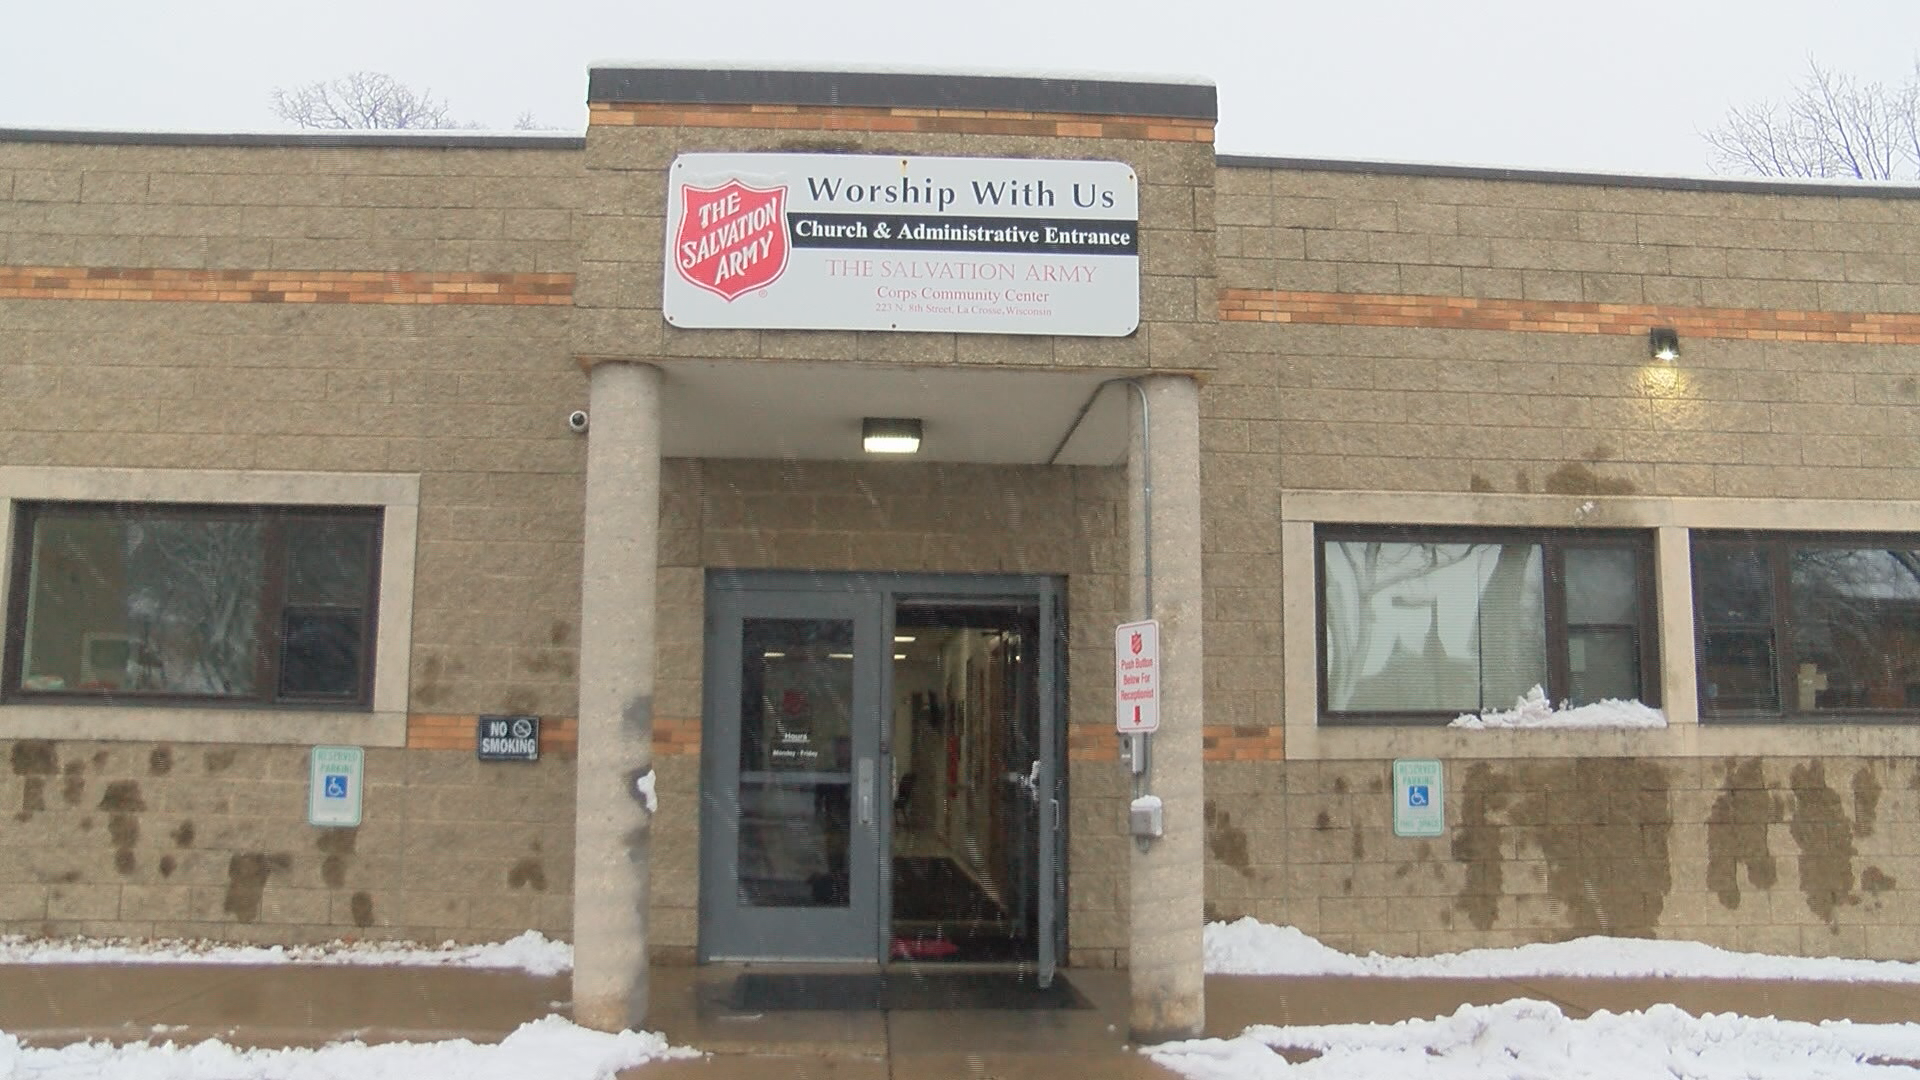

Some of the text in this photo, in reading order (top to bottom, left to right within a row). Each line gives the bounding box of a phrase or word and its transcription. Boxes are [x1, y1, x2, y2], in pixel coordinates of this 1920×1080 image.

[807, 176, 1114, 212] Worship With Us
[698, 191, 742, 229] THE
[682, 196, 777, 269] SALVATION
[795, 219, 1131, 245] Church & Administrative Entrance
[714, 230, 774, 286] ARMY
[825, 259, 1097, 282] THE SALVATION ARMY
[877, 285, 1050, 304] Corps Community Center
[875, 303, 892, 312] 223
[908, 303, 923, 313] 8th
[926, 303, 955, 315] Street,
[957, 304, 969, 314] La
[1006, 307, 1052, 316] Wisconsin
[1121, 659, 1153, 670] Push Button
[1123, 673, 1151, 685] Below For
[1120, 689, 1154, 700] Receptionist
[490, 721, 508, 737] NO
[784, 732, 808, 740] Hours
[482, 737, 536, 753] SMOKING
